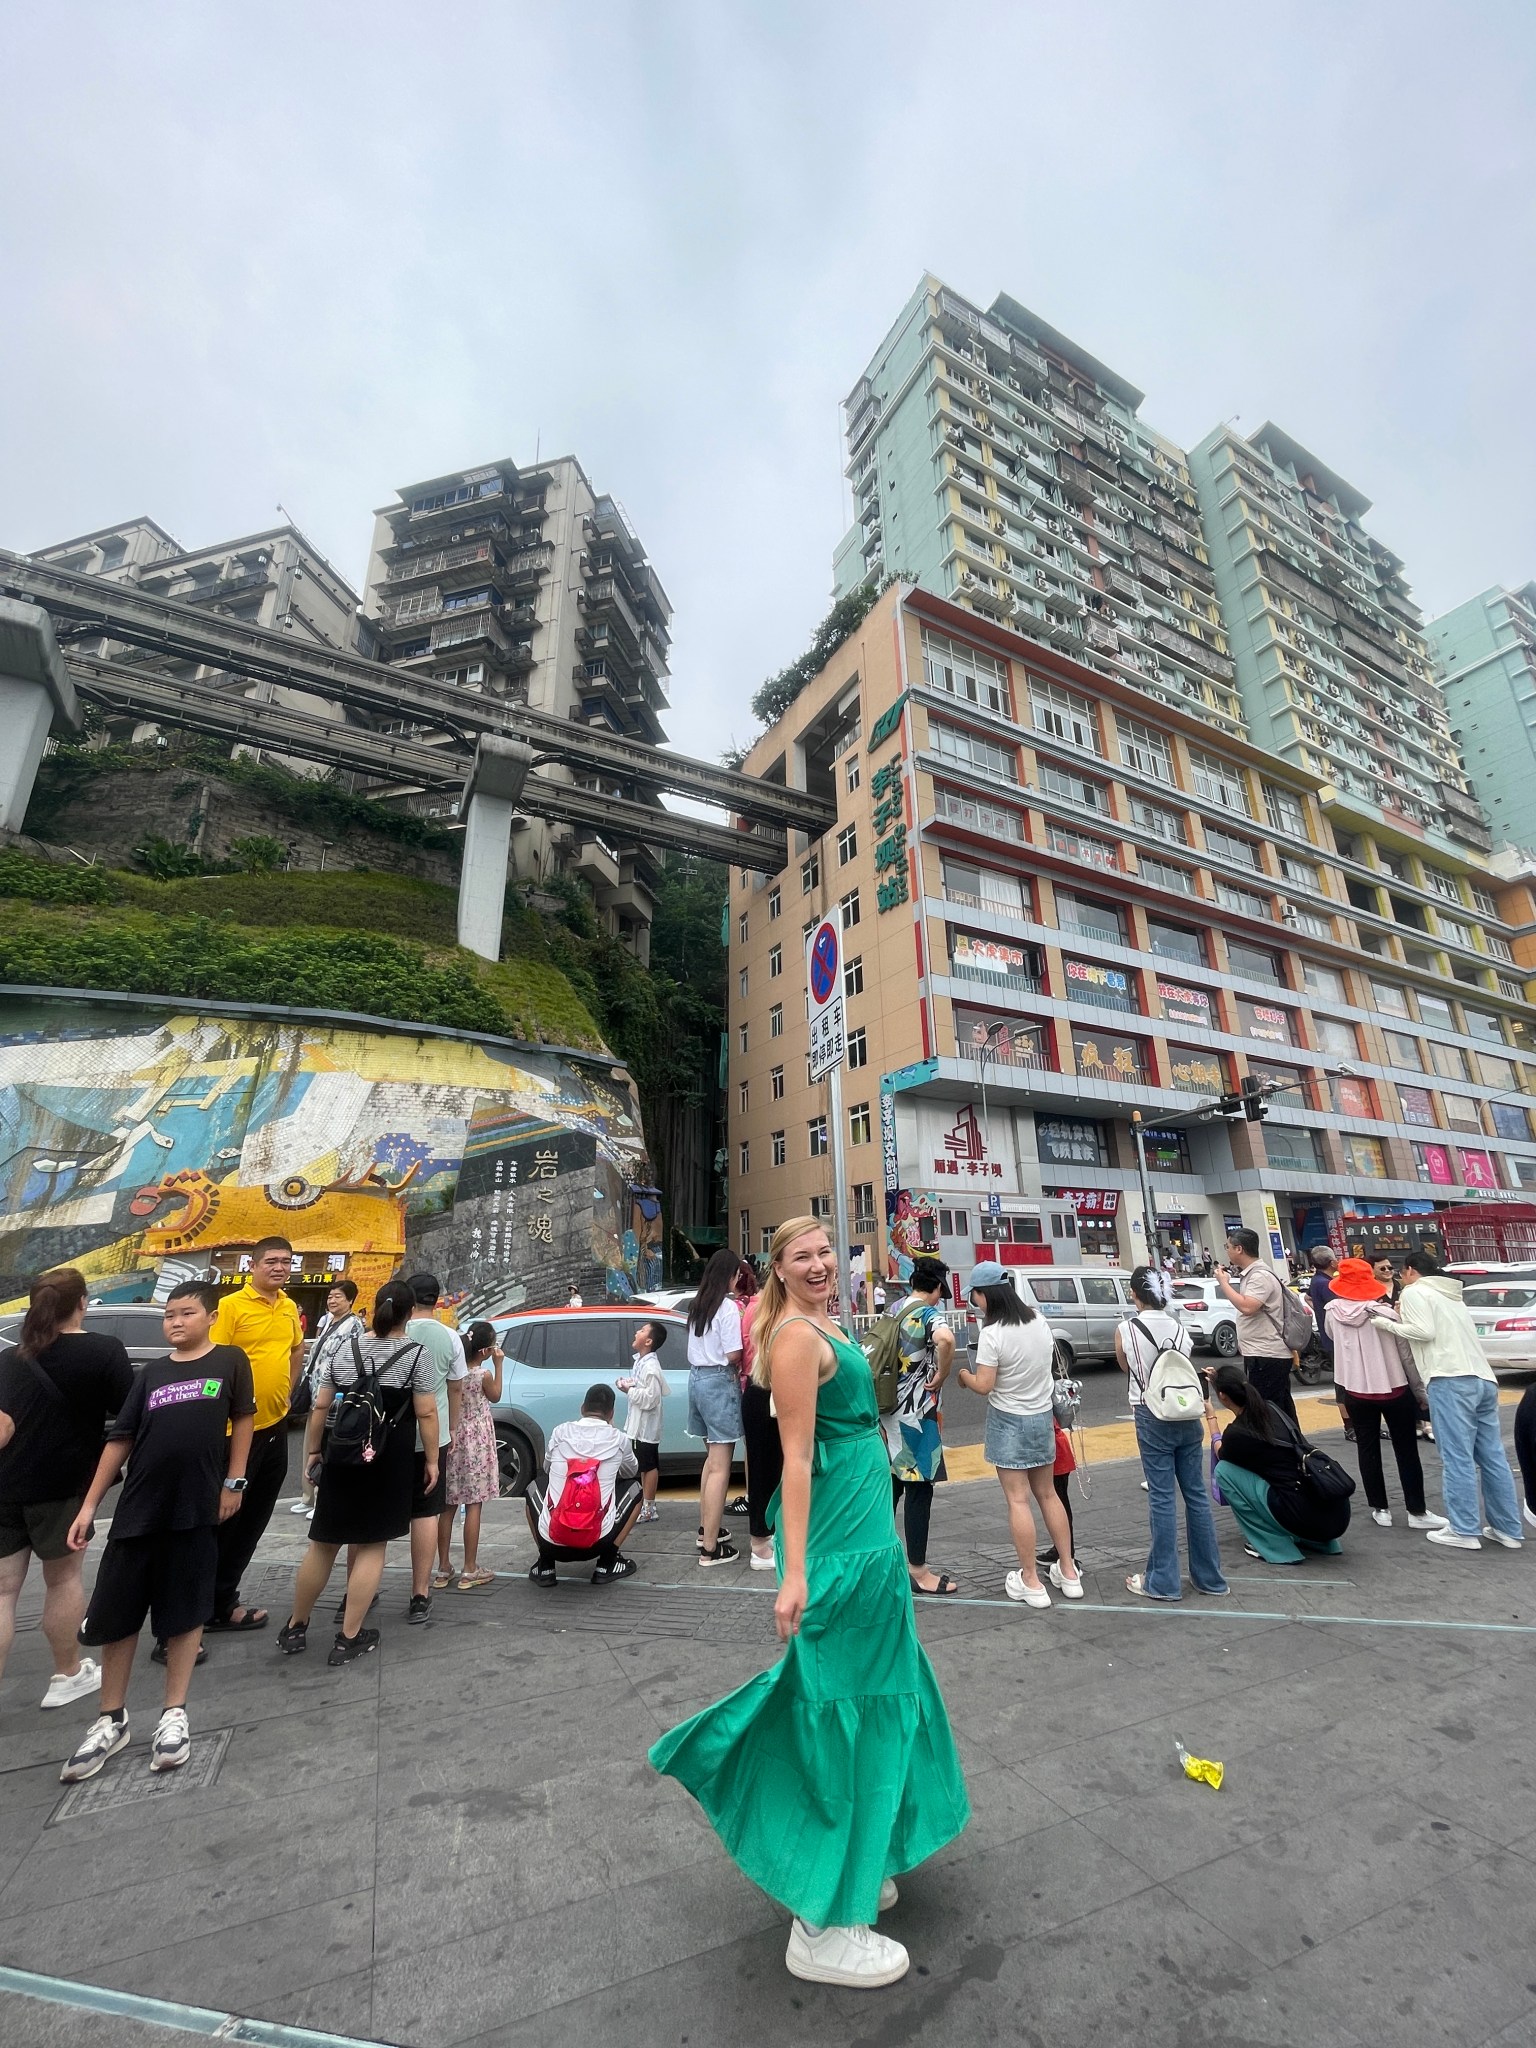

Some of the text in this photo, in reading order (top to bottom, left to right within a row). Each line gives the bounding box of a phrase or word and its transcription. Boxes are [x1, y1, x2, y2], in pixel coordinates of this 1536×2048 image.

[871, 763, 899, 915] 李子坝站
[972, 939, 1024, 967] 大虎集市
[811, 1005, 842, 1047] 出租车
[811, 1032, 843, 1070] 即停即走
[527, 1149, 559, 1244] 岩之魂
[991, 1195, 998, 1206] P
[302, 1273, 334, 1284] 无门票
[150, 1390, 200, 1408] is out there.
[152, 1380, 202, 1399] The Swoosh
